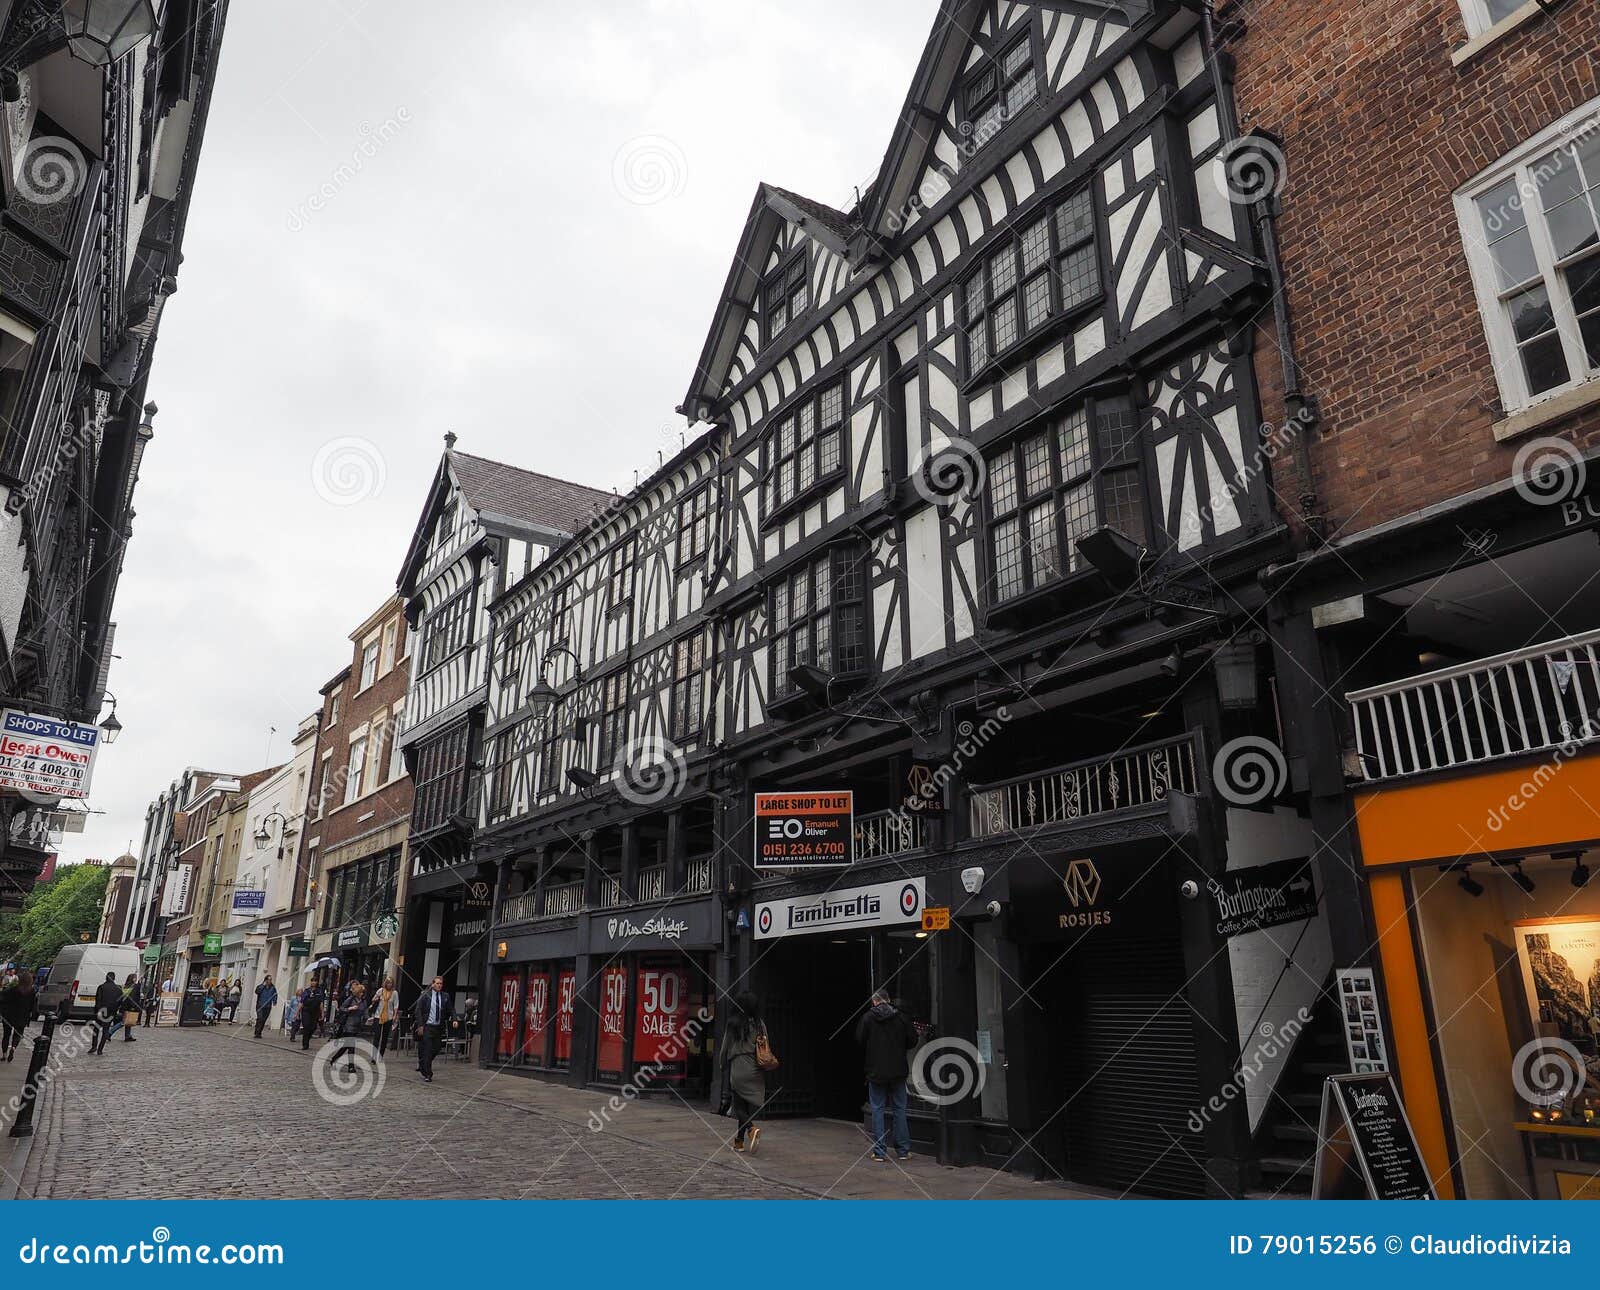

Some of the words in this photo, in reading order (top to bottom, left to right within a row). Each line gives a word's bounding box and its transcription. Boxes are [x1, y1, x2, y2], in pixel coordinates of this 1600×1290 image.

[8, 716, 51, 734] SHOPS
[54, 725, 71, 737] TO
[73, 729, 95, 742] LET
[0, 736, 41, 757] Legat
[45, 744, 89, 764] Owen
[40, 763, 84, 779] 408200
[13, 779, 25, 788] TO
[28, 782, 83, 798] RELOCATION
[760, 799, 790, 811] LARGE
[791, 798, 817, 810] SHOP
[818, 798, 831, 809] TO
[833, 797, 848, 809] LET
[804, 820, 839, 828] Emanuel
[804, 828, 828, 836] Oliver
[763, 844, 786, 856] 0151
[790, 843, 812, 855] 236
[815, 842, 845, 854] 6700
[177, 866, 191, 911] Jewellers
[1217, 878, 1287, 920] Burlingtons
[787, 894, 881, 929] Lambretta
[1059, 910, 1111, 929] ROSIES
[619, 919, 642, 938] Miss
[641, 917, 689, 940] Selfridge
[1216, 920, 1241, 934] Coffee
[1241, 916, 1260, 929] Shop
[503, 980, 518, 1013] 50
[531, 978, 546, 1013] 50
[606, 973, 623, 1014] 50
[643, 972, 679, 1014] 50
[502, 1014, 515, 1030] SALE
[530, 1014, 543, 1031] SALE
[603, 1014, 622, 1033] SALE
[642, 1014, 677, 1034] SALE
